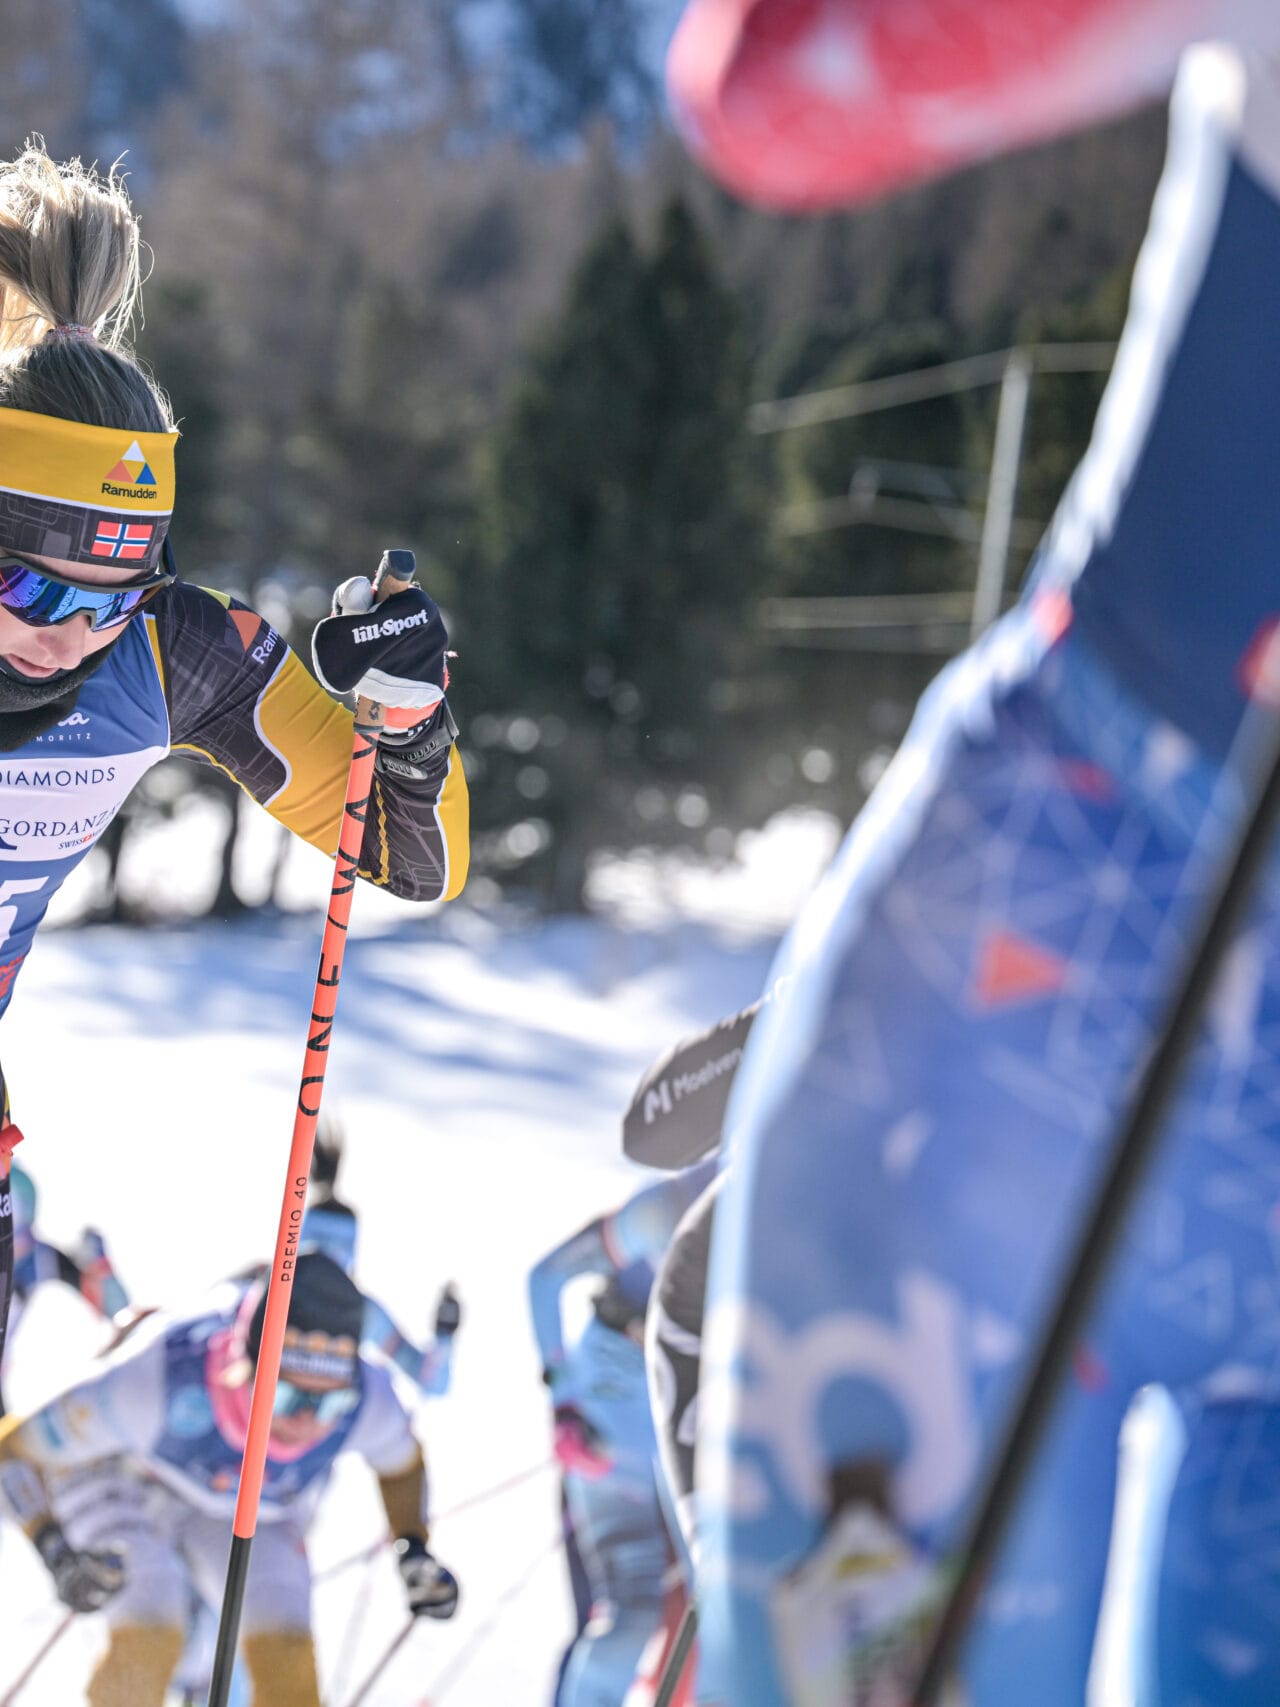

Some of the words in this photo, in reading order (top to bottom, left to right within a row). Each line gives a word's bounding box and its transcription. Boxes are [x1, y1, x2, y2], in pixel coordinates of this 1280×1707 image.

[101, 482, 157, 499] Ramudden
[280, 1209, 302, 1282] PREMIO
[294, 1176, 308, 1200] 40
